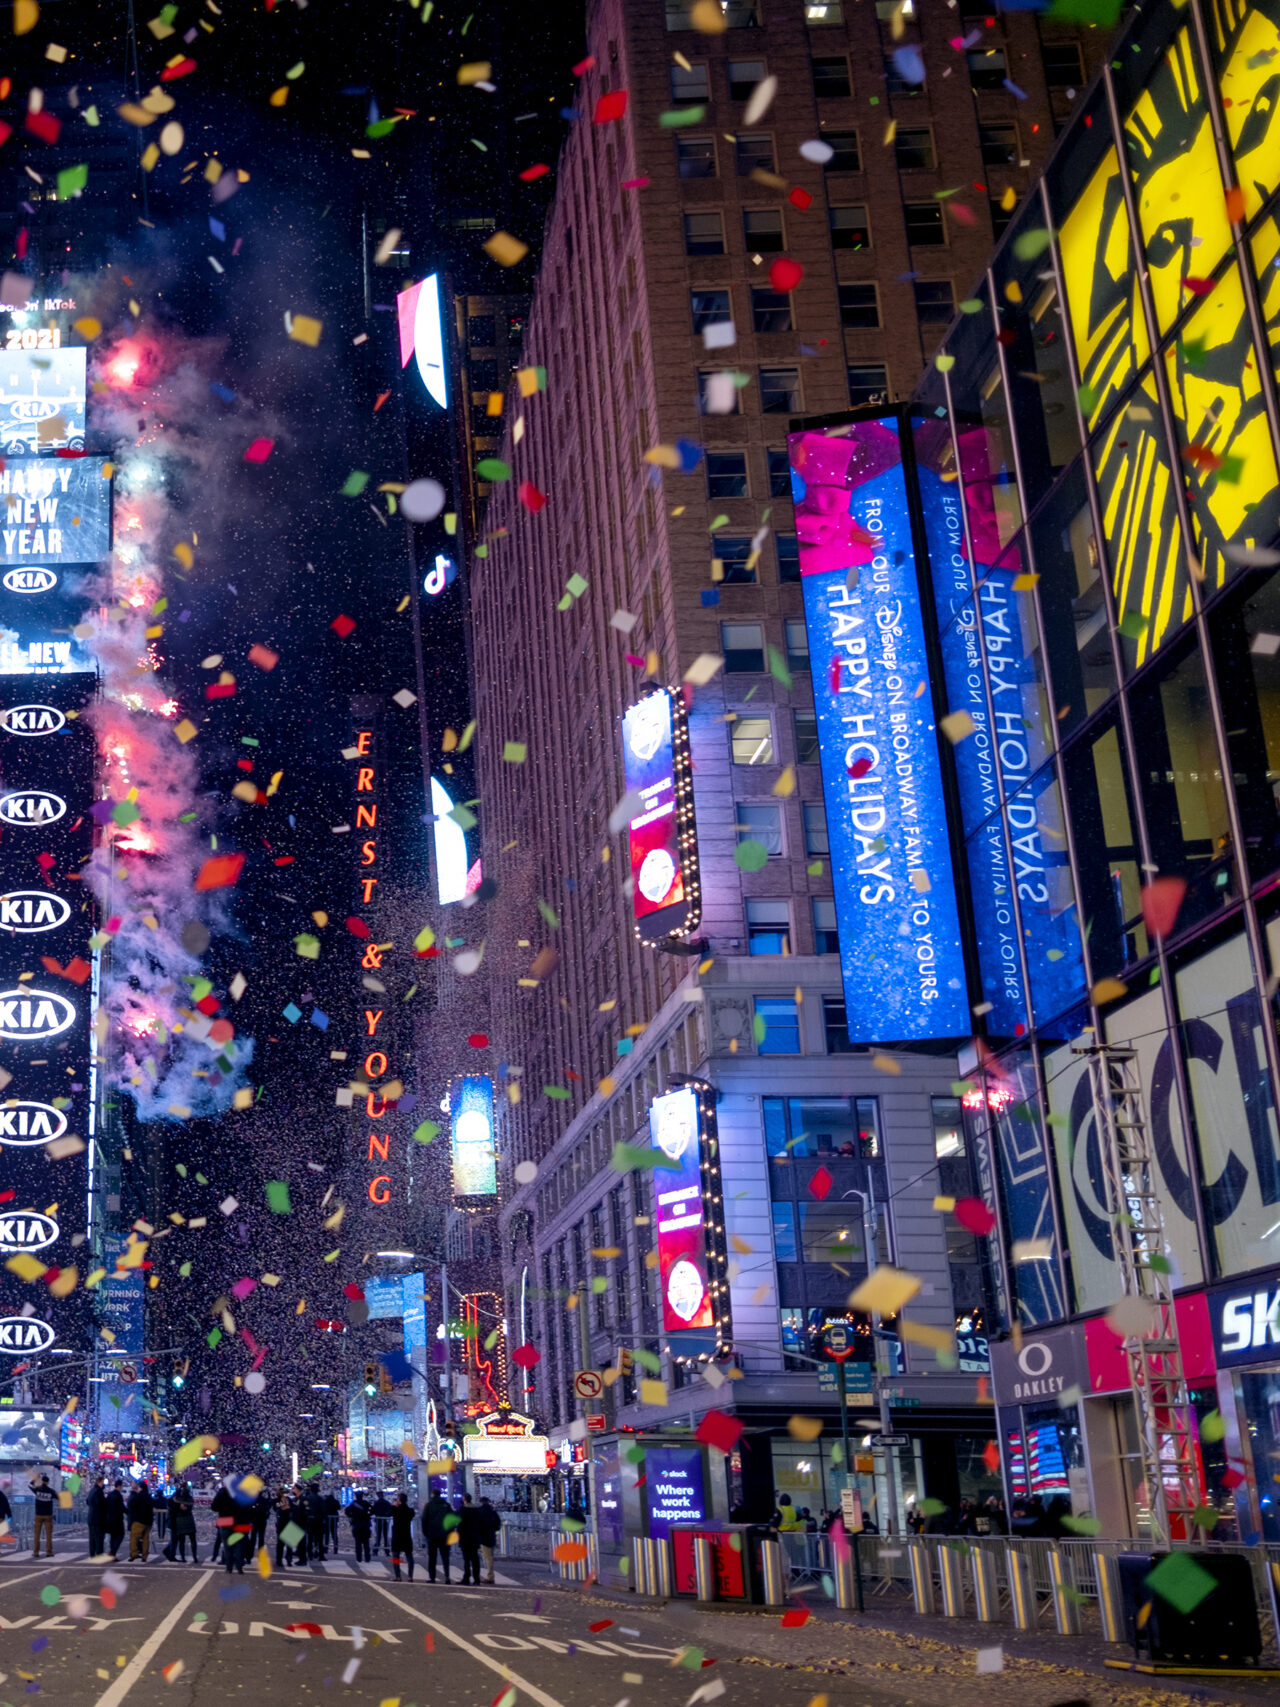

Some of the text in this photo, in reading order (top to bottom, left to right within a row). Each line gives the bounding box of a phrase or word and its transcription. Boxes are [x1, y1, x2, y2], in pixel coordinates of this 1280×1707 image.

[6, 328, 61, 350] 2021
[6, 498, 58, 525] NEW
[865, 498, 886, 549] FROM
[2, 529, 62, 555] YEAR
[13, 573, 48, 587] KIA
[872, 555, 890, 595] OUR
[885, 676, 904, 706] ON
[12, 712, 54, 730] KIA
[827, 584, 896, 905] HAPPY HOLIDAYS
[890, 712, 918, 819] BROADWAY
[8, 798, 55, 818] KIA
[902, 826, 922, 890] FAMI
[1, 900, 57, 923] KIA
[912, 899, 931, 926] TO
[356, 731, 392, 1205] ERNST & YOUNG
[974, 1114, 997, 1215] NEWS
[1013, 1376, 1065, 1399] OAKLEY
[655, 1484, 695, 1496] Where
[661, 1497, 691, 1508] work
[652, 1507, 701, 1520] happens
[186, 1619, 413, 1645] ONLY
[472, 1631, 697, 1661] ONLY
